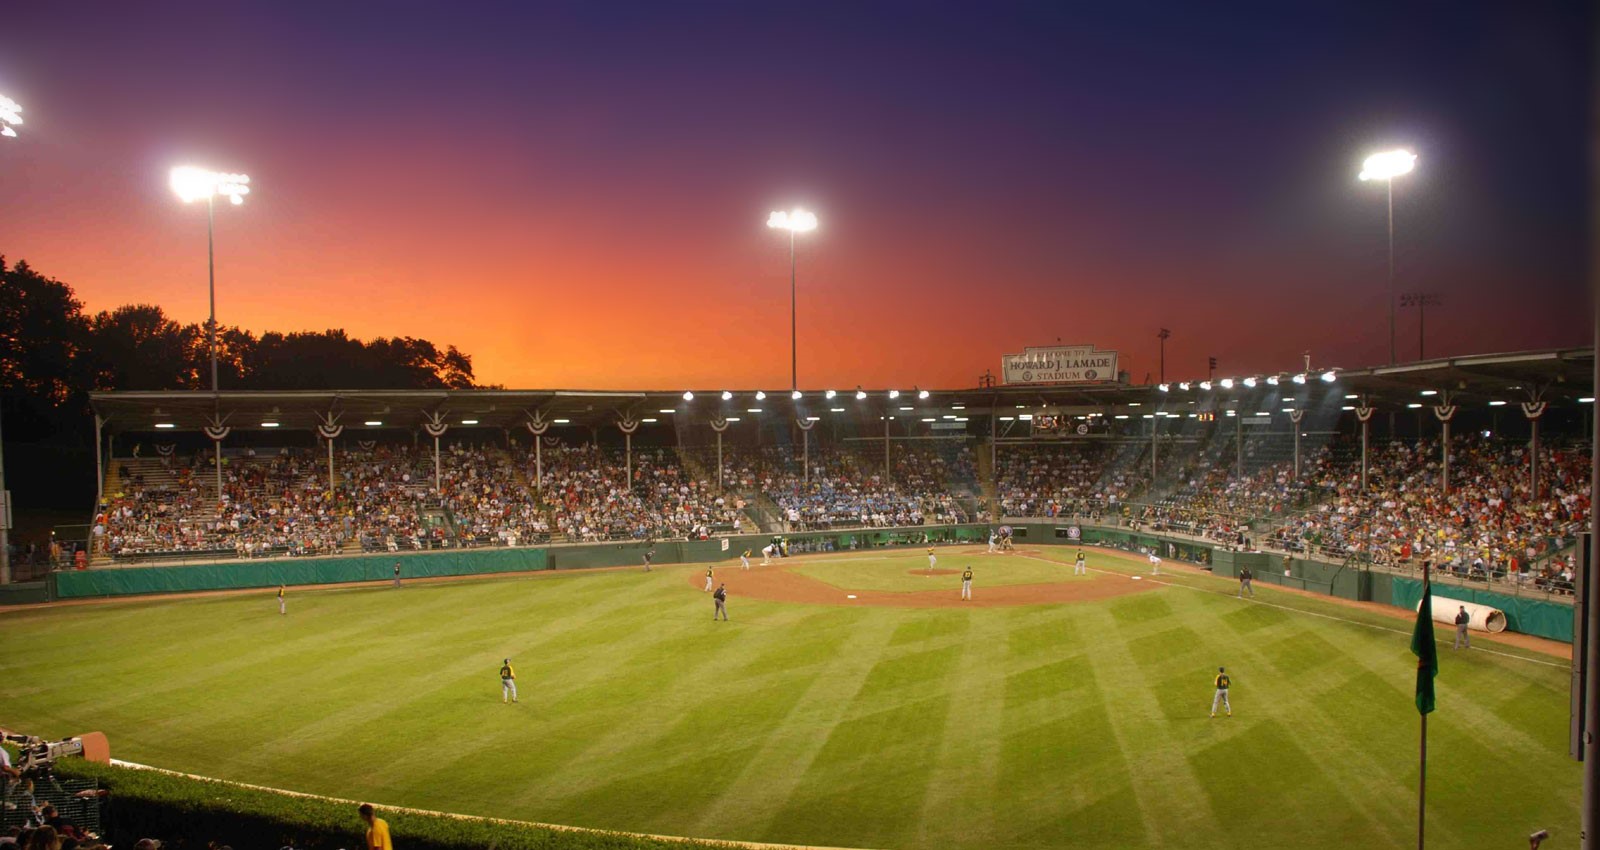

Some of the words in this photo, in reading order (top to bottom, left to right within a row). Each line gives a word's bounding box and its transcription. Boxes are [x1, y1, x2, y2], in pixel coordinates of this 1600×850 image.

[1010, 361, 1054, 371] HOWARD
[1055, 361, 1063, 372] J.
[1066, 359, 1110, 369] LAMADE
[1037, 371, 1080, 380] STADIUM
